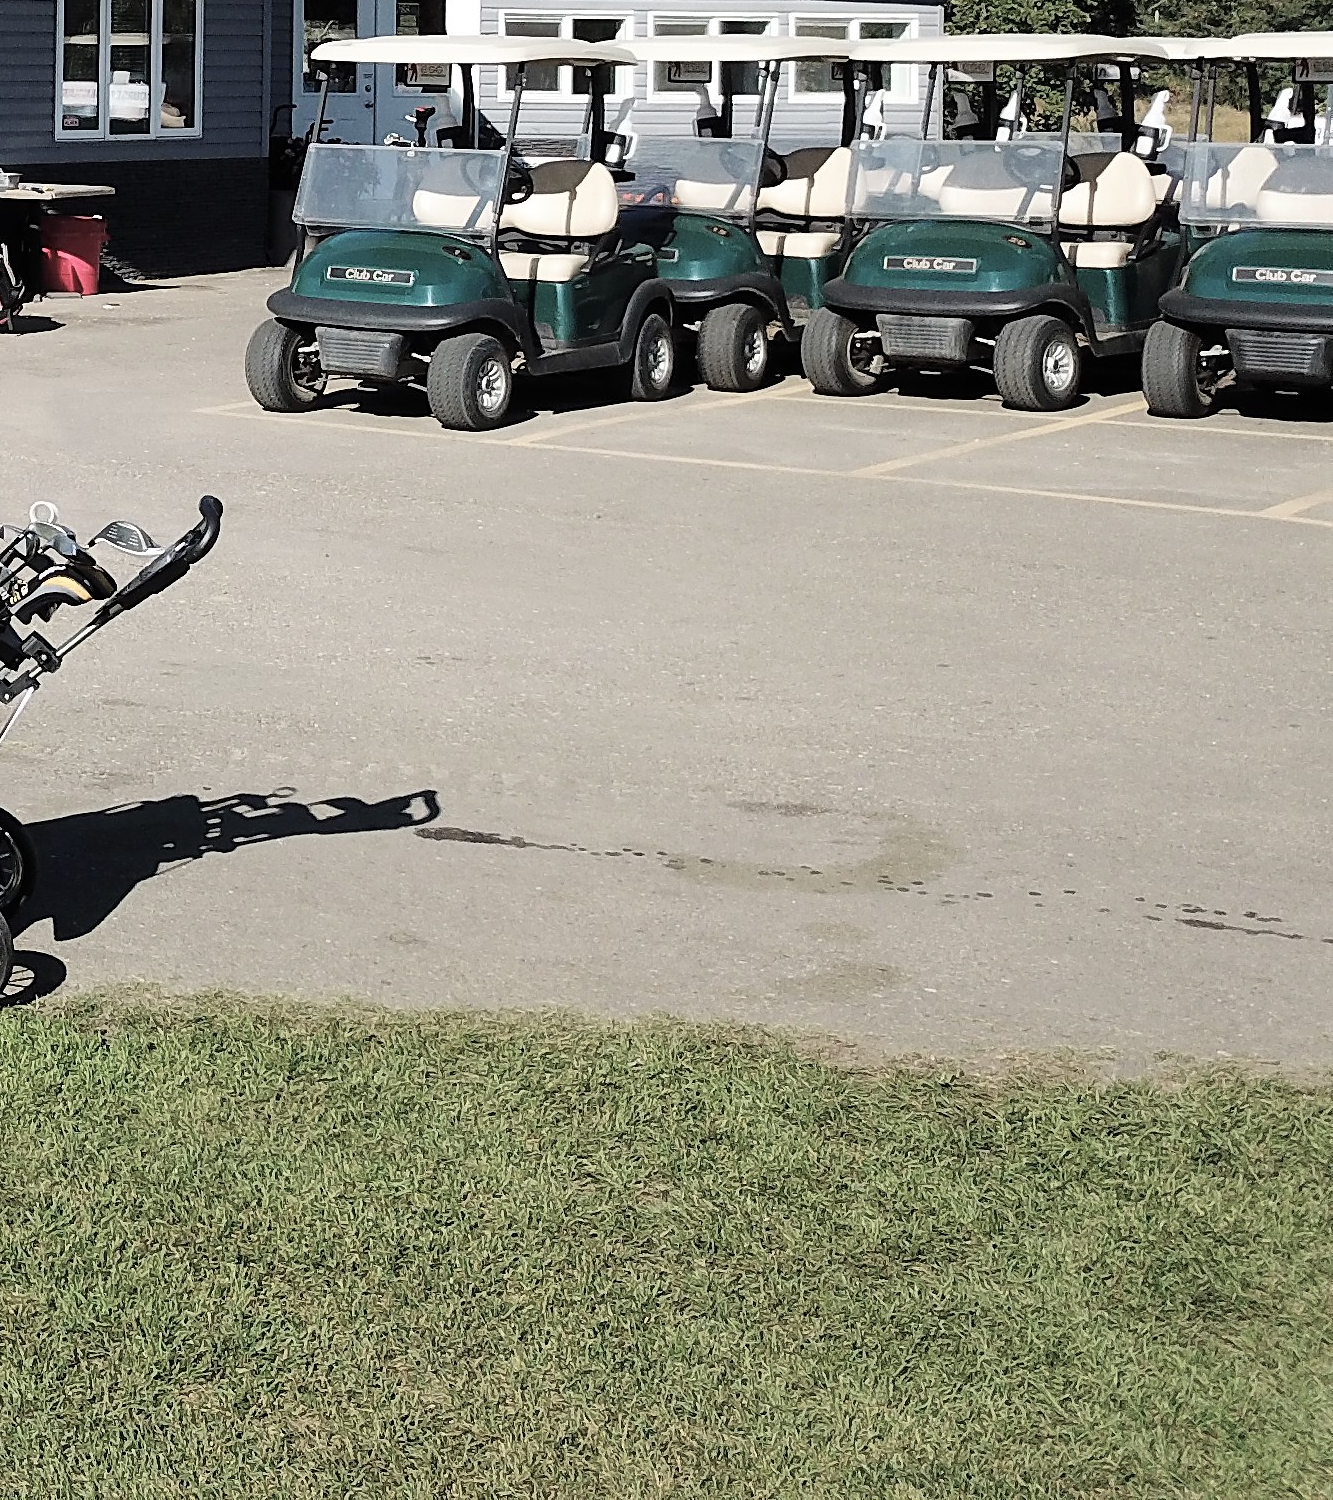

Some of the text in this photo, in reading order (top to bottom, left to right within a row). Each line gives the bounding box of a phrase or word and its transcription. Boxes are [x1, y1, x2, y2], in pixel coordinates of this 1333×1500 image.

[903, 258, 956, 270] Club Car
[345, 269, 395, 282] Club Car
[1255, 269, 1317, 282] Club Car
